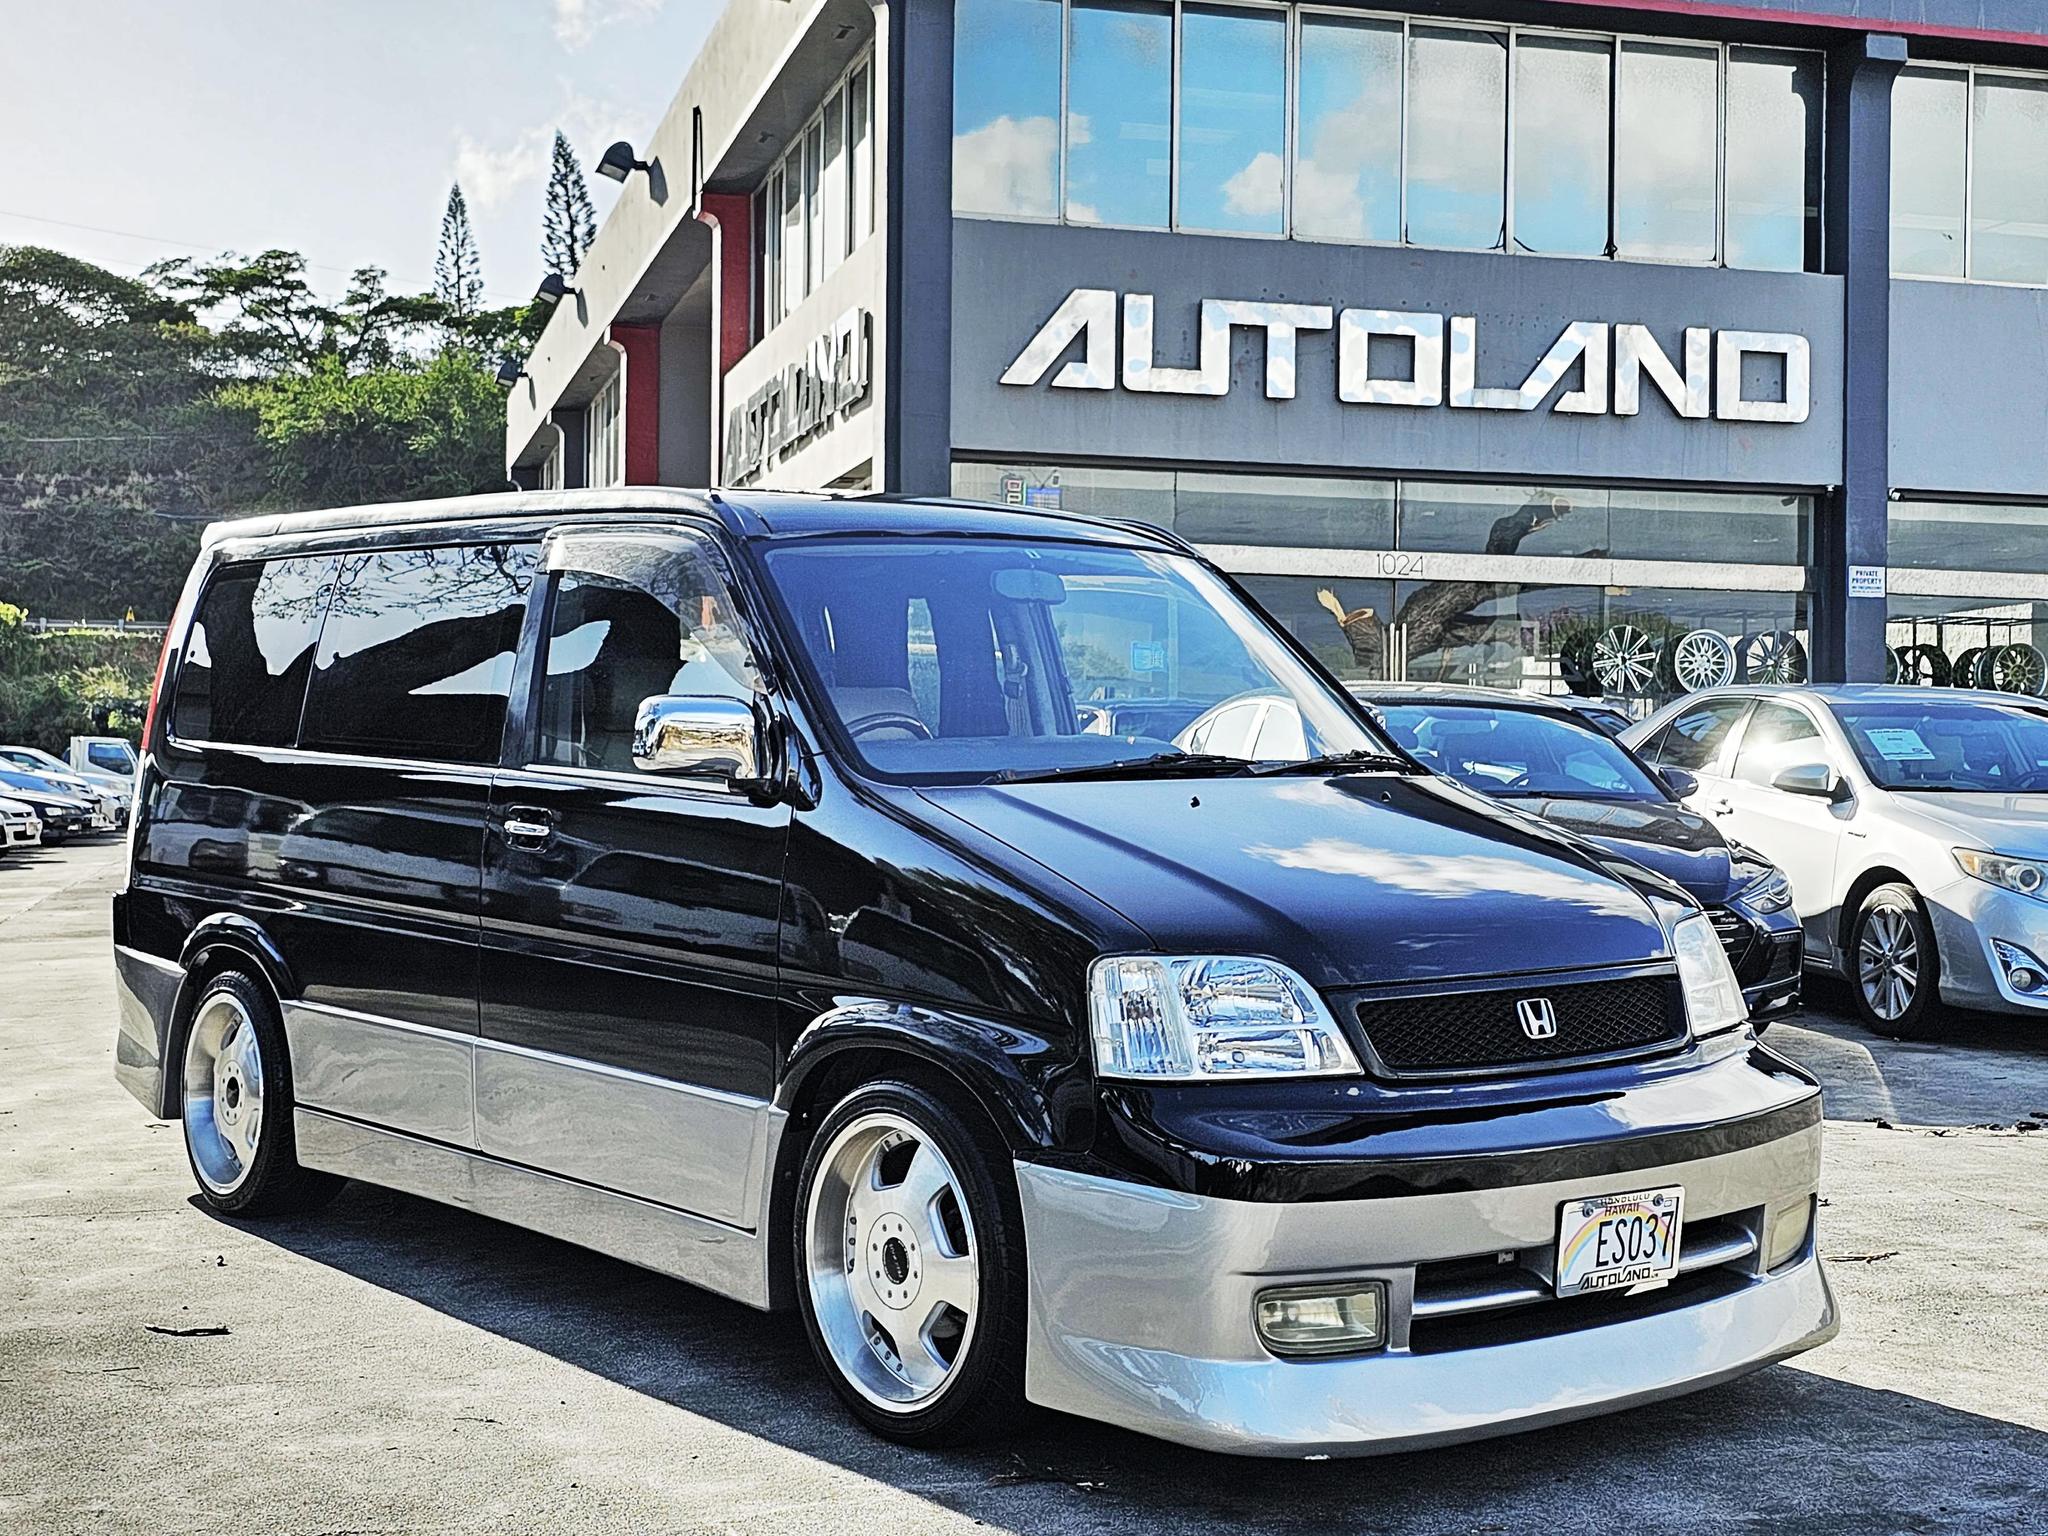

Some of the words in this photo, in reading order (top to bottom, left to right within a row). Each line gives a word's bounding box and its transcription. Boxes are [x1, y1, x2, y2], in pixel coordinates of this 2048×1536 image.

[1000, 288, 1811, 423] AUTOLAND
[1377, 553, 1424, 577] 1024
[1851, 577, 1882, 585] PROPERTY
[1604, 1203, 1640, 1217] HAWAII
[1580, 1267, 1651, 1290] AUTOLAND
